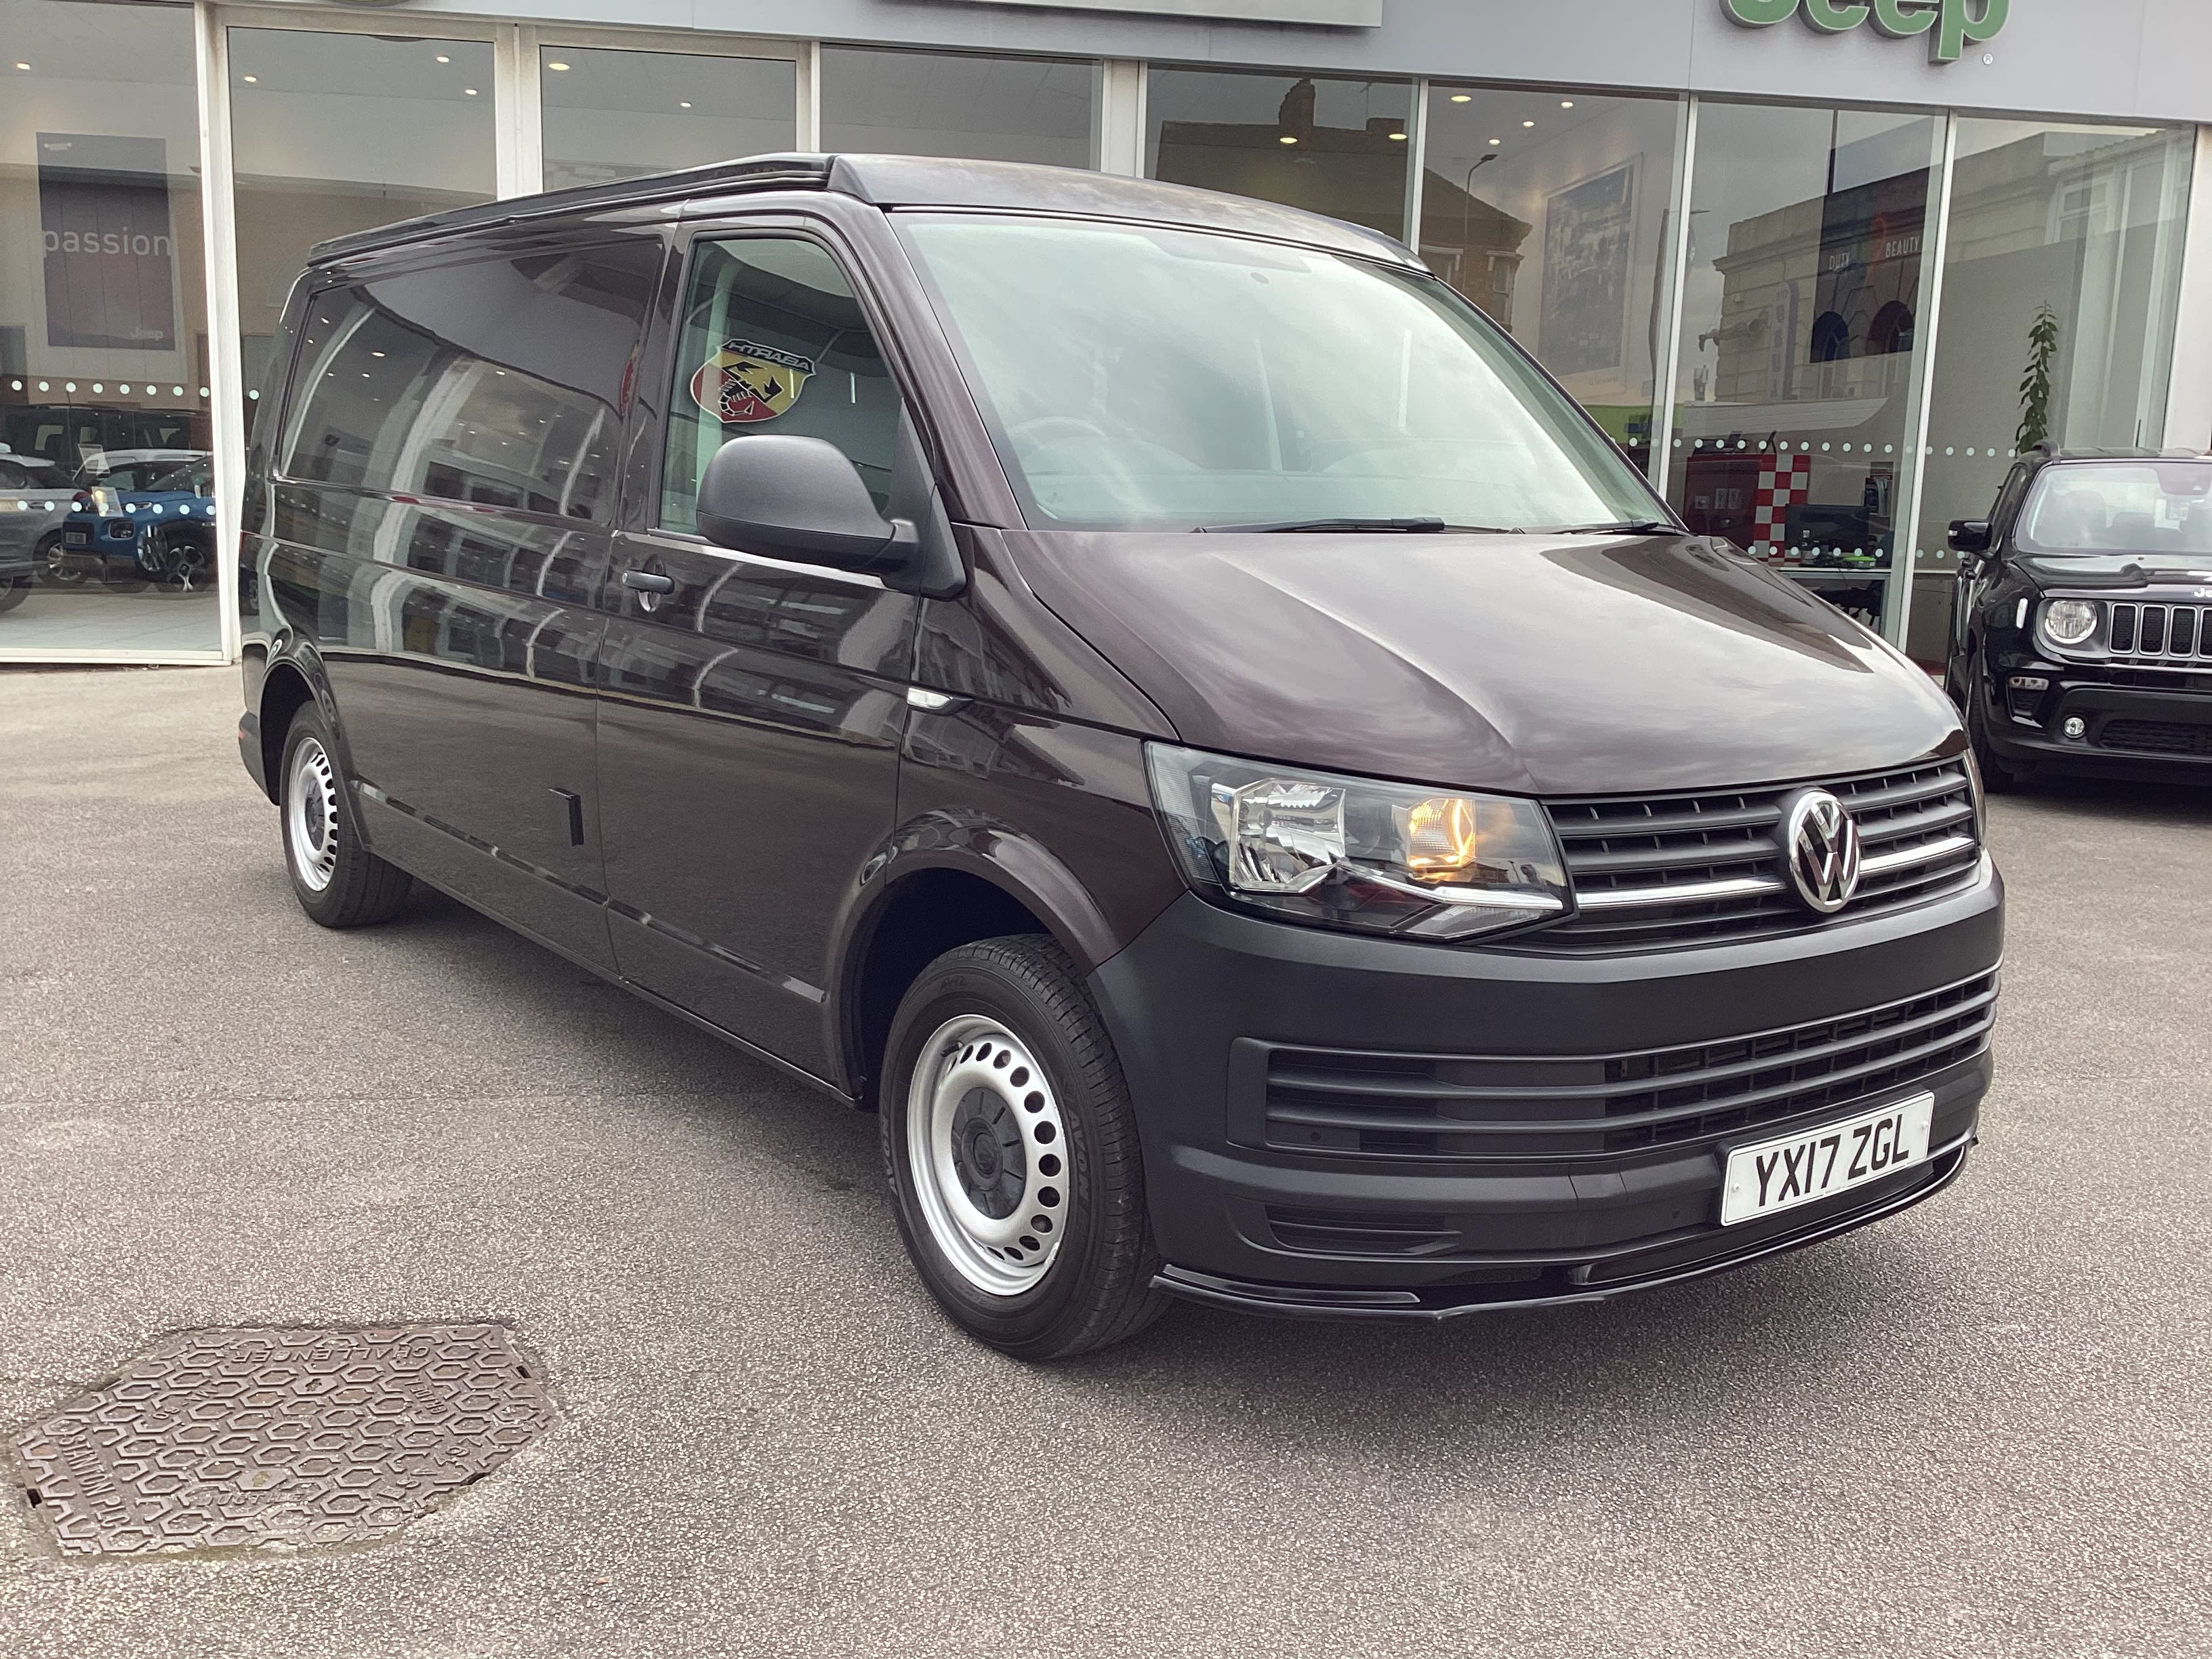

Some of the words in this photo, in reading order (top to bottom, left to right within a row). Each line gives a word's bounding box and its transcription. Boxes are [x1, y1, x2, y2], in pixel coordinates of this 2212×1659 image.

[1721, 0, 2009, 61] ep
[43, 226, 171, 258] passion
[1885, 236, 1921, 259] BEAUTY
[1755, 1134, 1841, 1207] YX17
[1847, 1113, 1909, 1180] ZGL
[232, 1345, 430, 1364] CHALLENGER
[59, 1435, 115, 1497] STANTON
[90, 1496, 130, 1528] PLC
